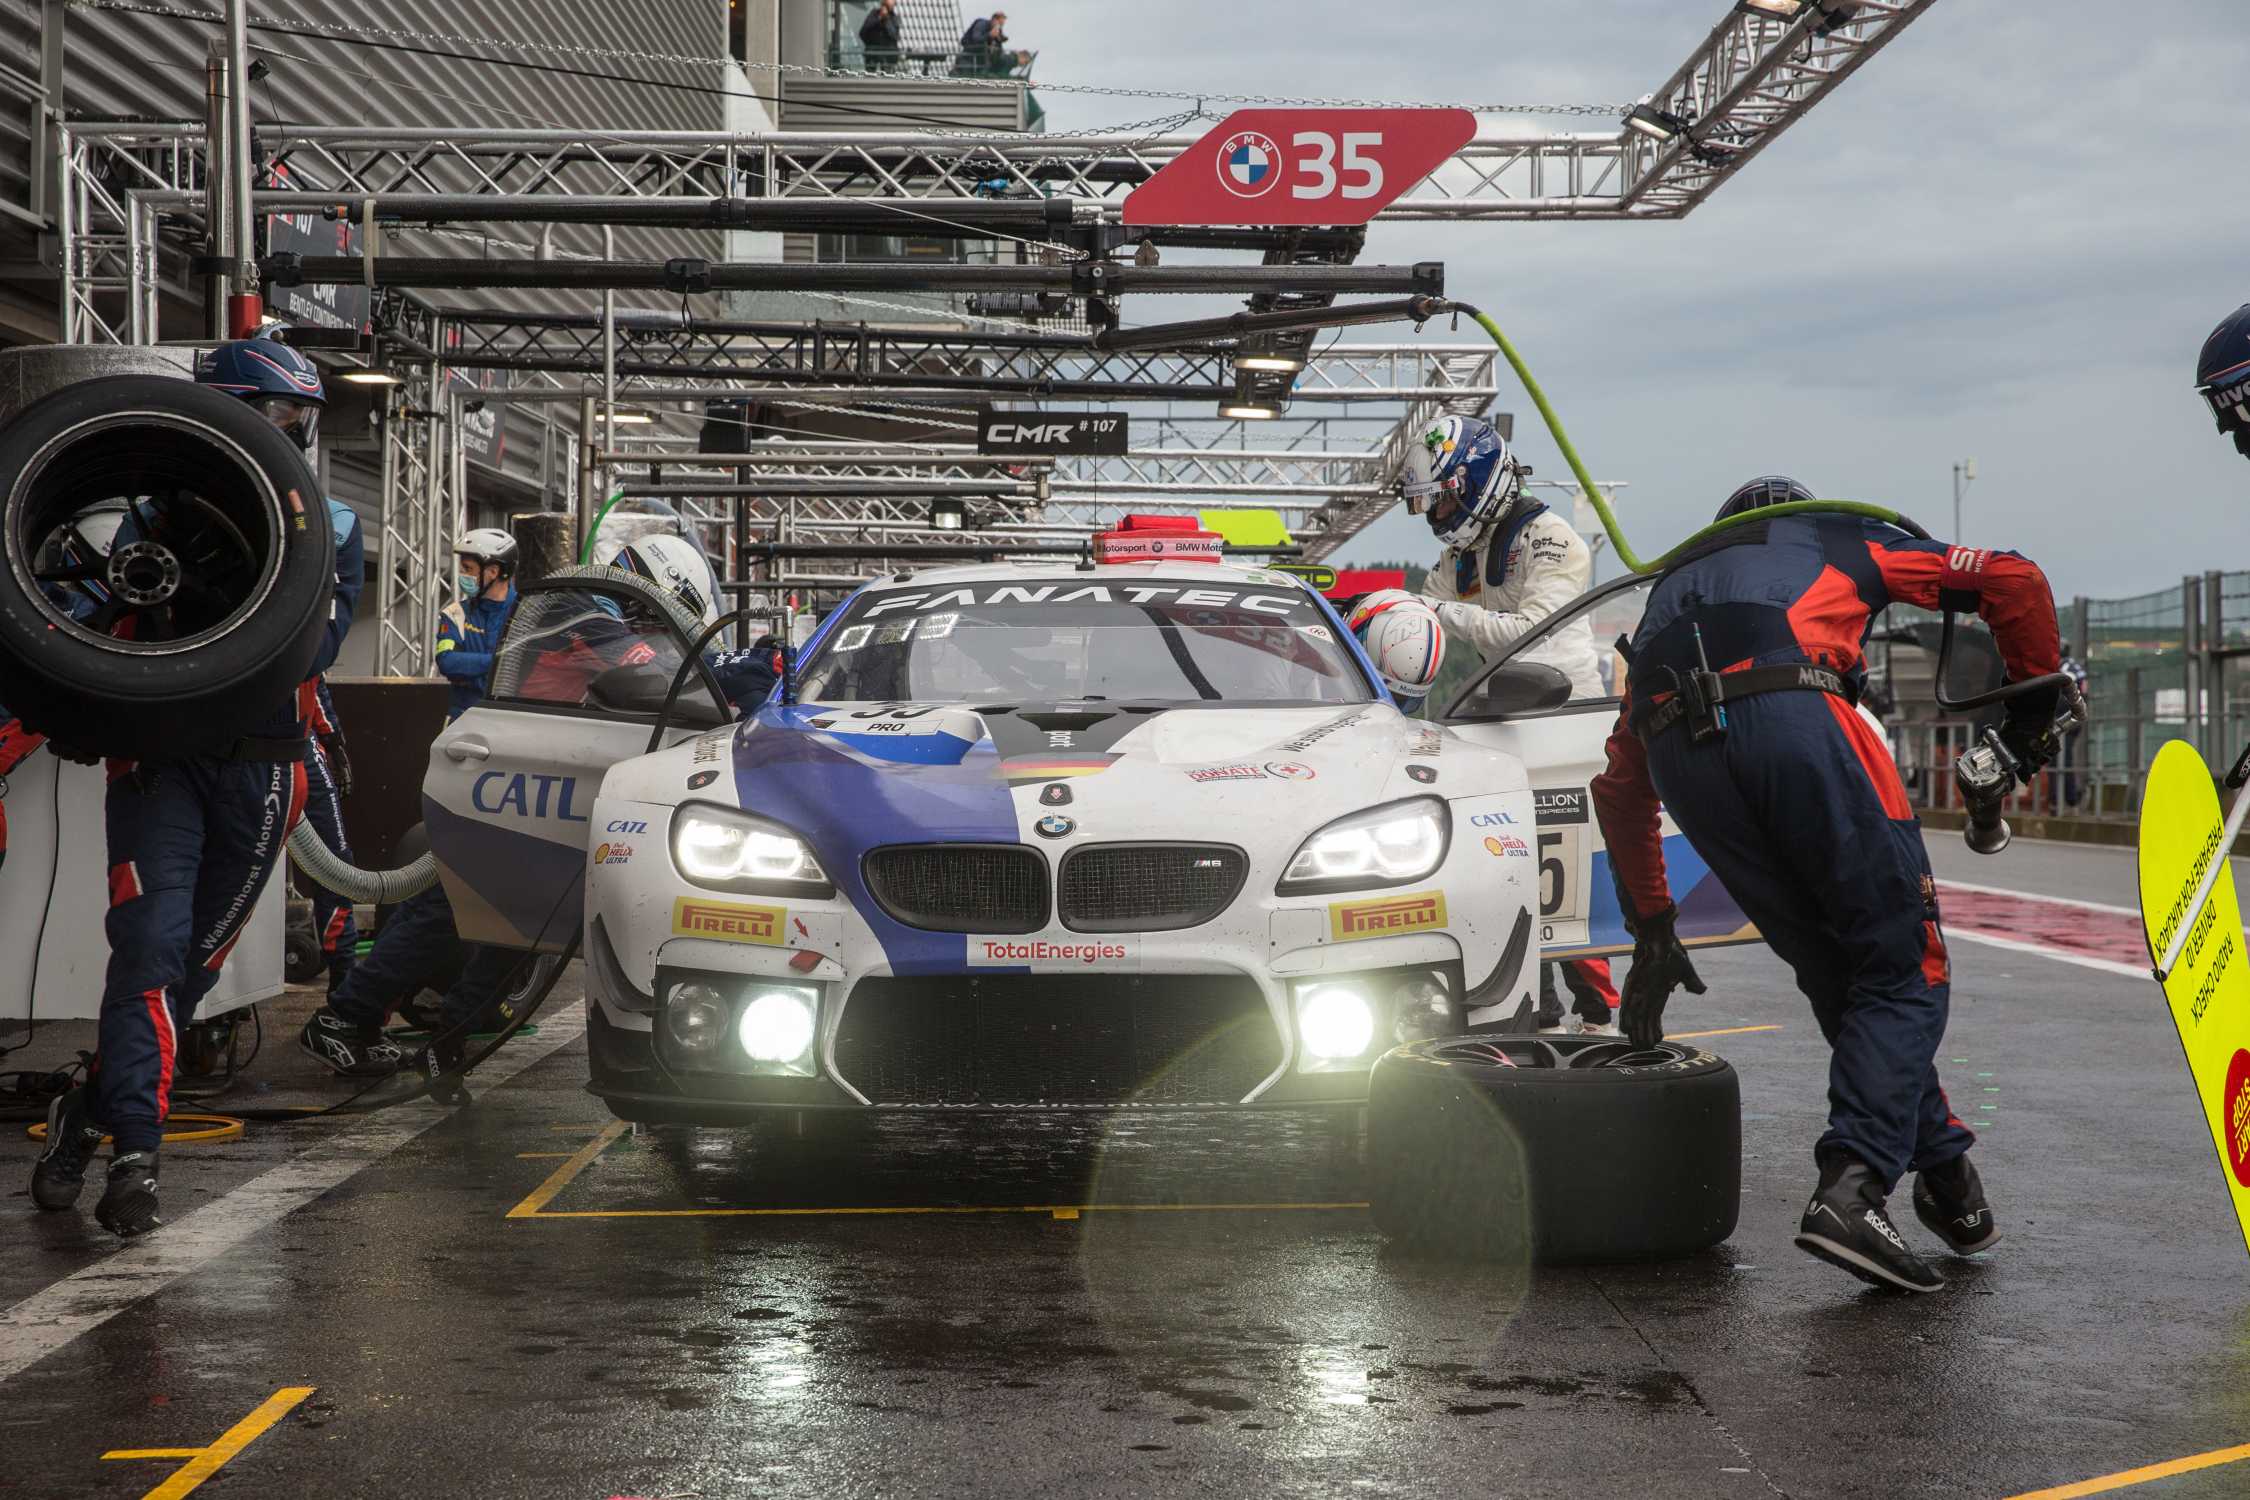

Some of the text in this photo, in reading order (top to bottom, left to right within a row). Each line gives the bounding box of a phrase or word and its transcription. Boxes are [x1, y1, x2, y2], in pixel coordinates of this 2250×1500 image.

[1225, 134, 1273, 154] BMW
[1292, 131, 1384, 199] 35
[289, 292, 313, 319] BENTLEY
[986, 424, 1074, 443] CMR
[1092, 419, 1117, 432] 107
[1176, 543, 1200, 552] BMW
[863, 586, 1300, 618] FANATEC
[867, 723, 905, 733] PRO
[472, 771, 588, 822] CATL
[606, 820, 648, 834] CATL
[1471, 813, 1520, 827] CATL
[1506, 849, 1529, 857] ULTRA
[2193, 817, 2223, 884] PREPARE
[2182, 869, 2196, 909] FOR
[201, 865, 263, 950] Walkenhorst
[681, 904, 774, 937] PIRELLI
[1341, 898, 1437, 933] PIRELLI
[2191, 897, 2217, 957] DRIVER
[983, 941, 1126, 963] TotalEnergies
[2190, 932, 2234, 1028] RADIO CHECK
